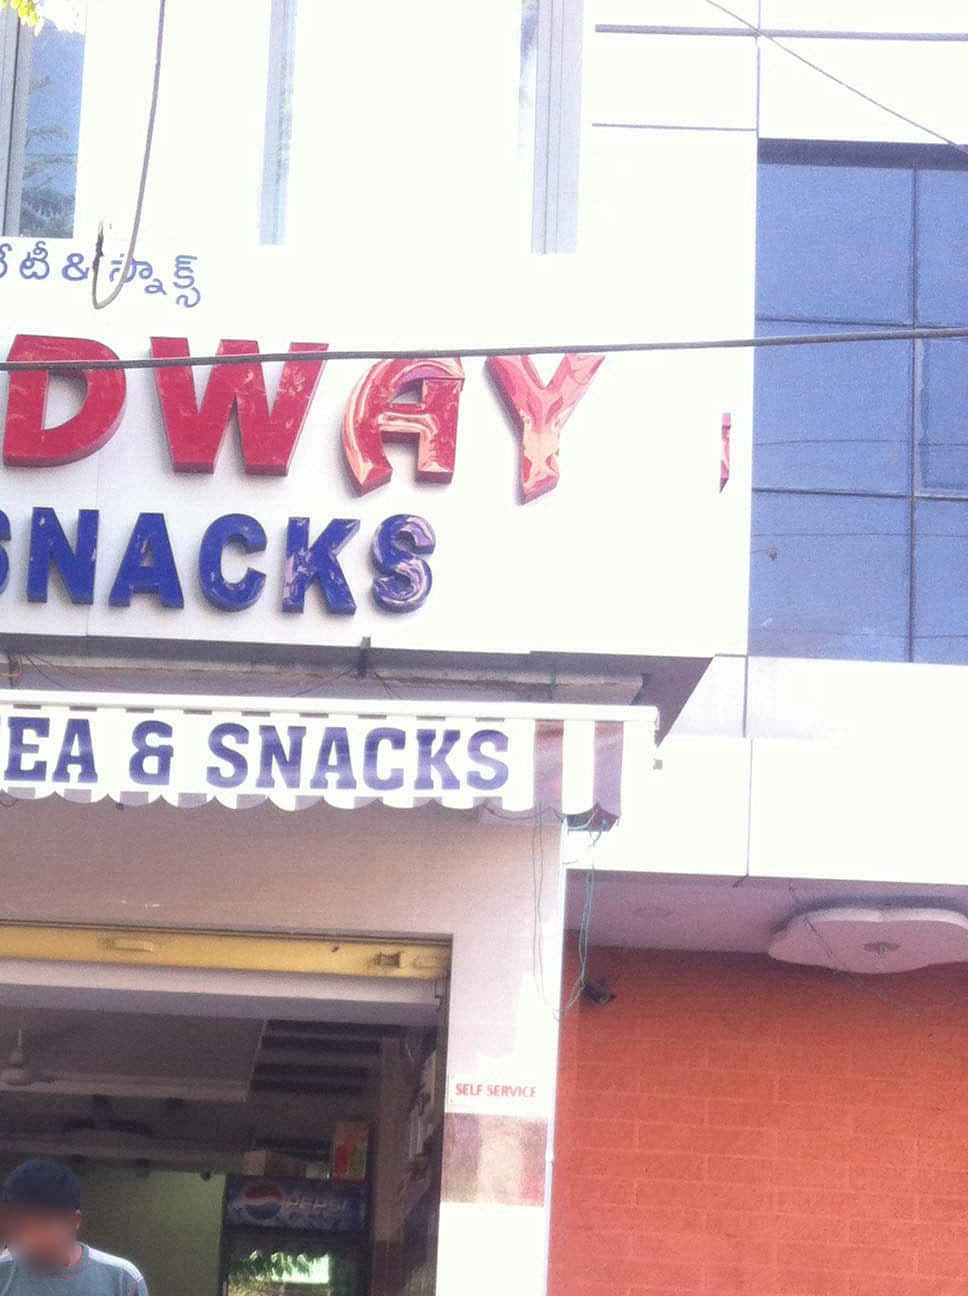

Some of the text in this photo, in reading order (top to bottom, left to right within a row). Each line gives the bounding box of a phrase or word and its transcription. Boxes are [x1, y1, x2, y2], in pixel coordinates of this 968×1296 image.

[62, 253, 90, 281] &
[128, 720, 174, 787] &
[206, 721, 511, 792] SNACKS
[455, 1083, 537, 1098] SELF SERVICE
